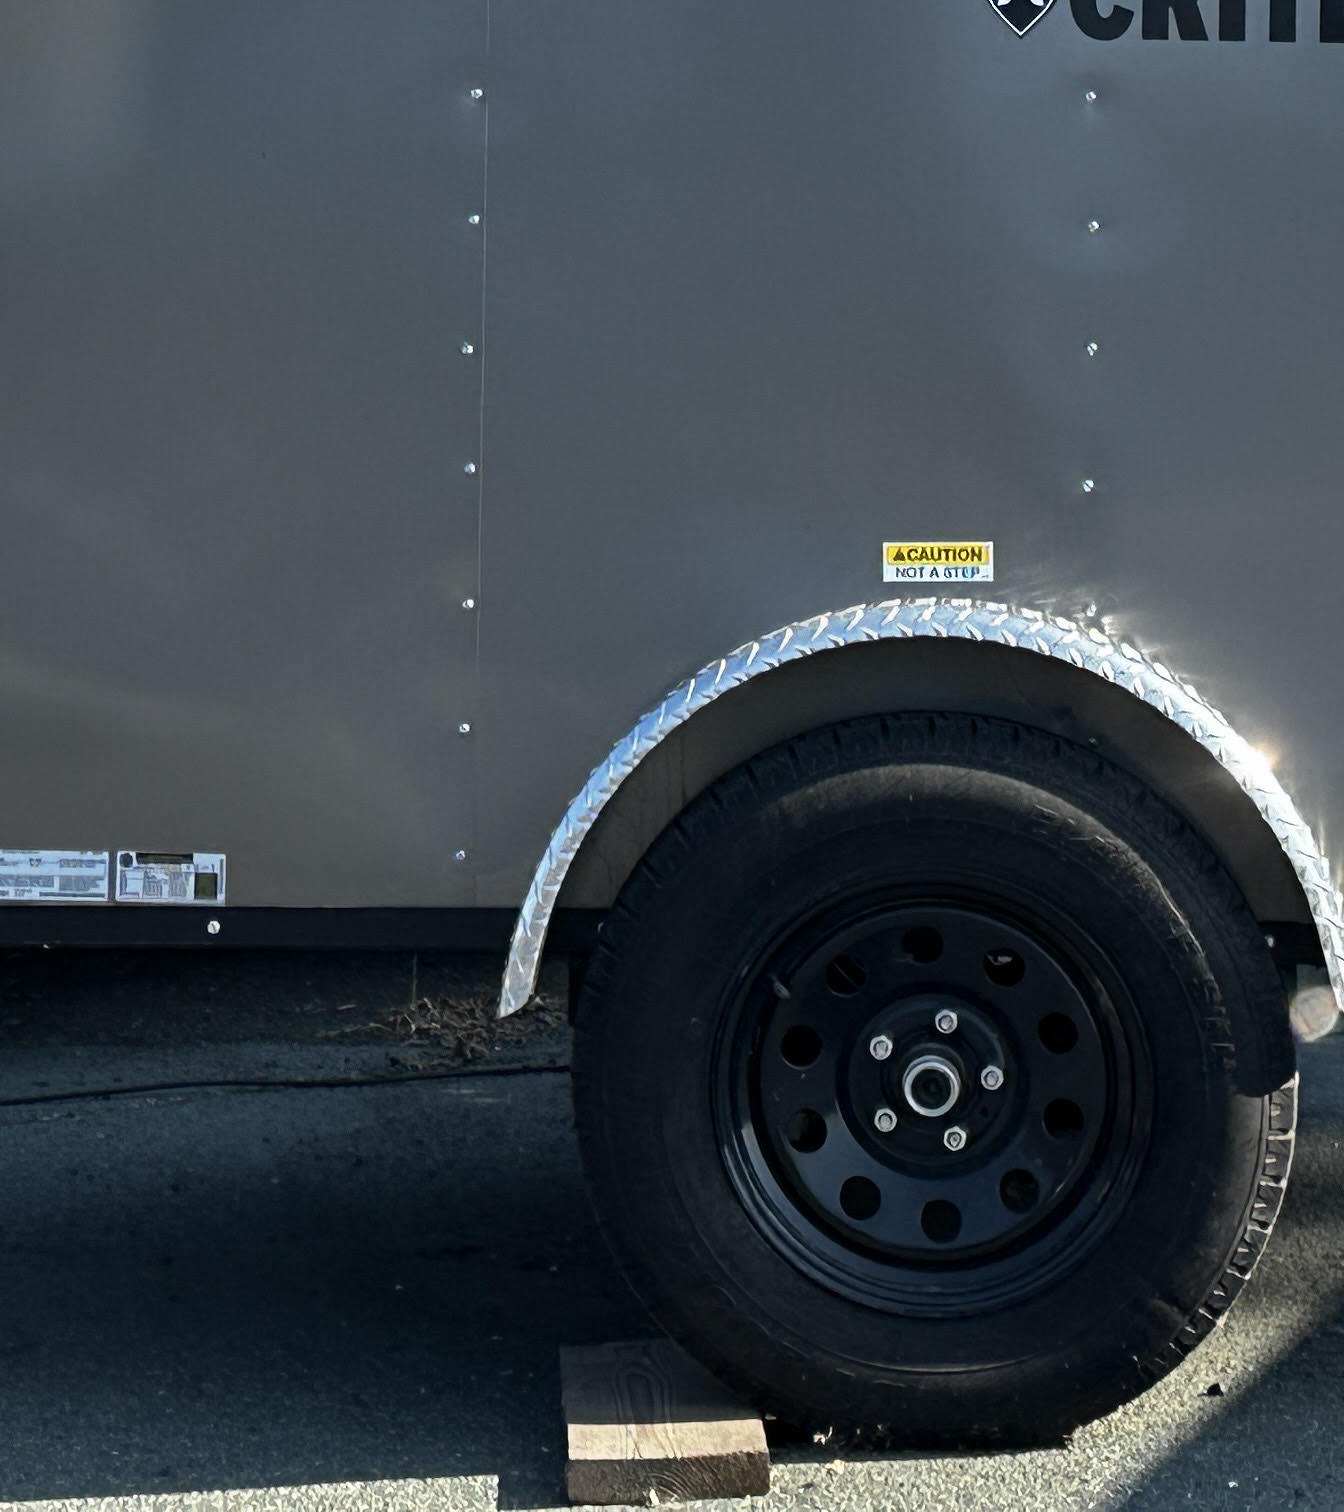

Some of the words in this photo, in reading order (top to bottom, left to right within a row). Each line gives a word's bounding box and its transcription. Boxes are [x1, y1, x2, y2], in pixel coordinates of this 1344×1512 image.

[907, 547, 983, 562] CAUTION
[896, 567, 925, 578] NOT
[929, 567, 940, 578] A
